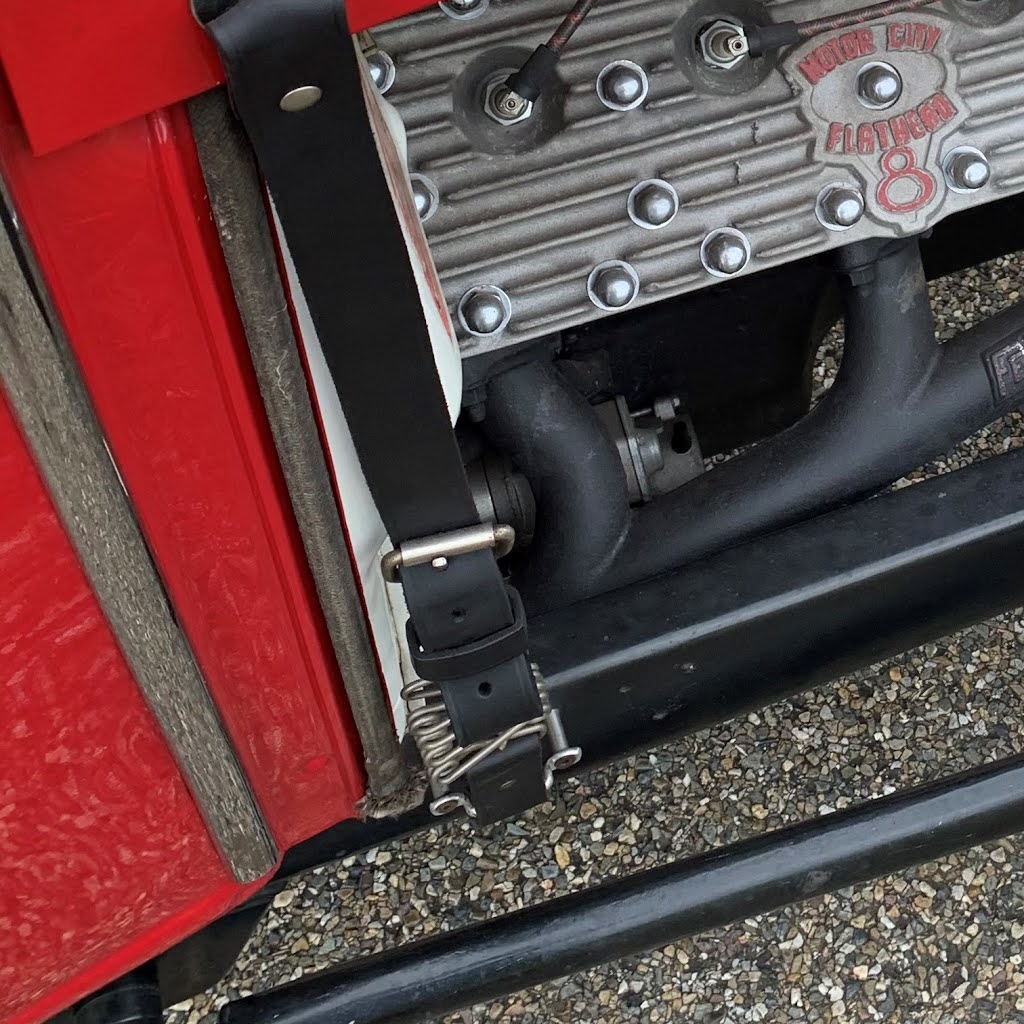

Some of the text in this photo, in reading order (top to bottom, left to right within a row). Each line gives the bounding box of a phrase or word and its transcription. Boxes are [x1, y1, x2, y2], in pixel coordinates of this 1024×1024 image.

[797, 21, 942, 86] MOTOR CITY
[826, 90, 959, 155] FLATHEAD
[876, 145, 938, 214] 8
